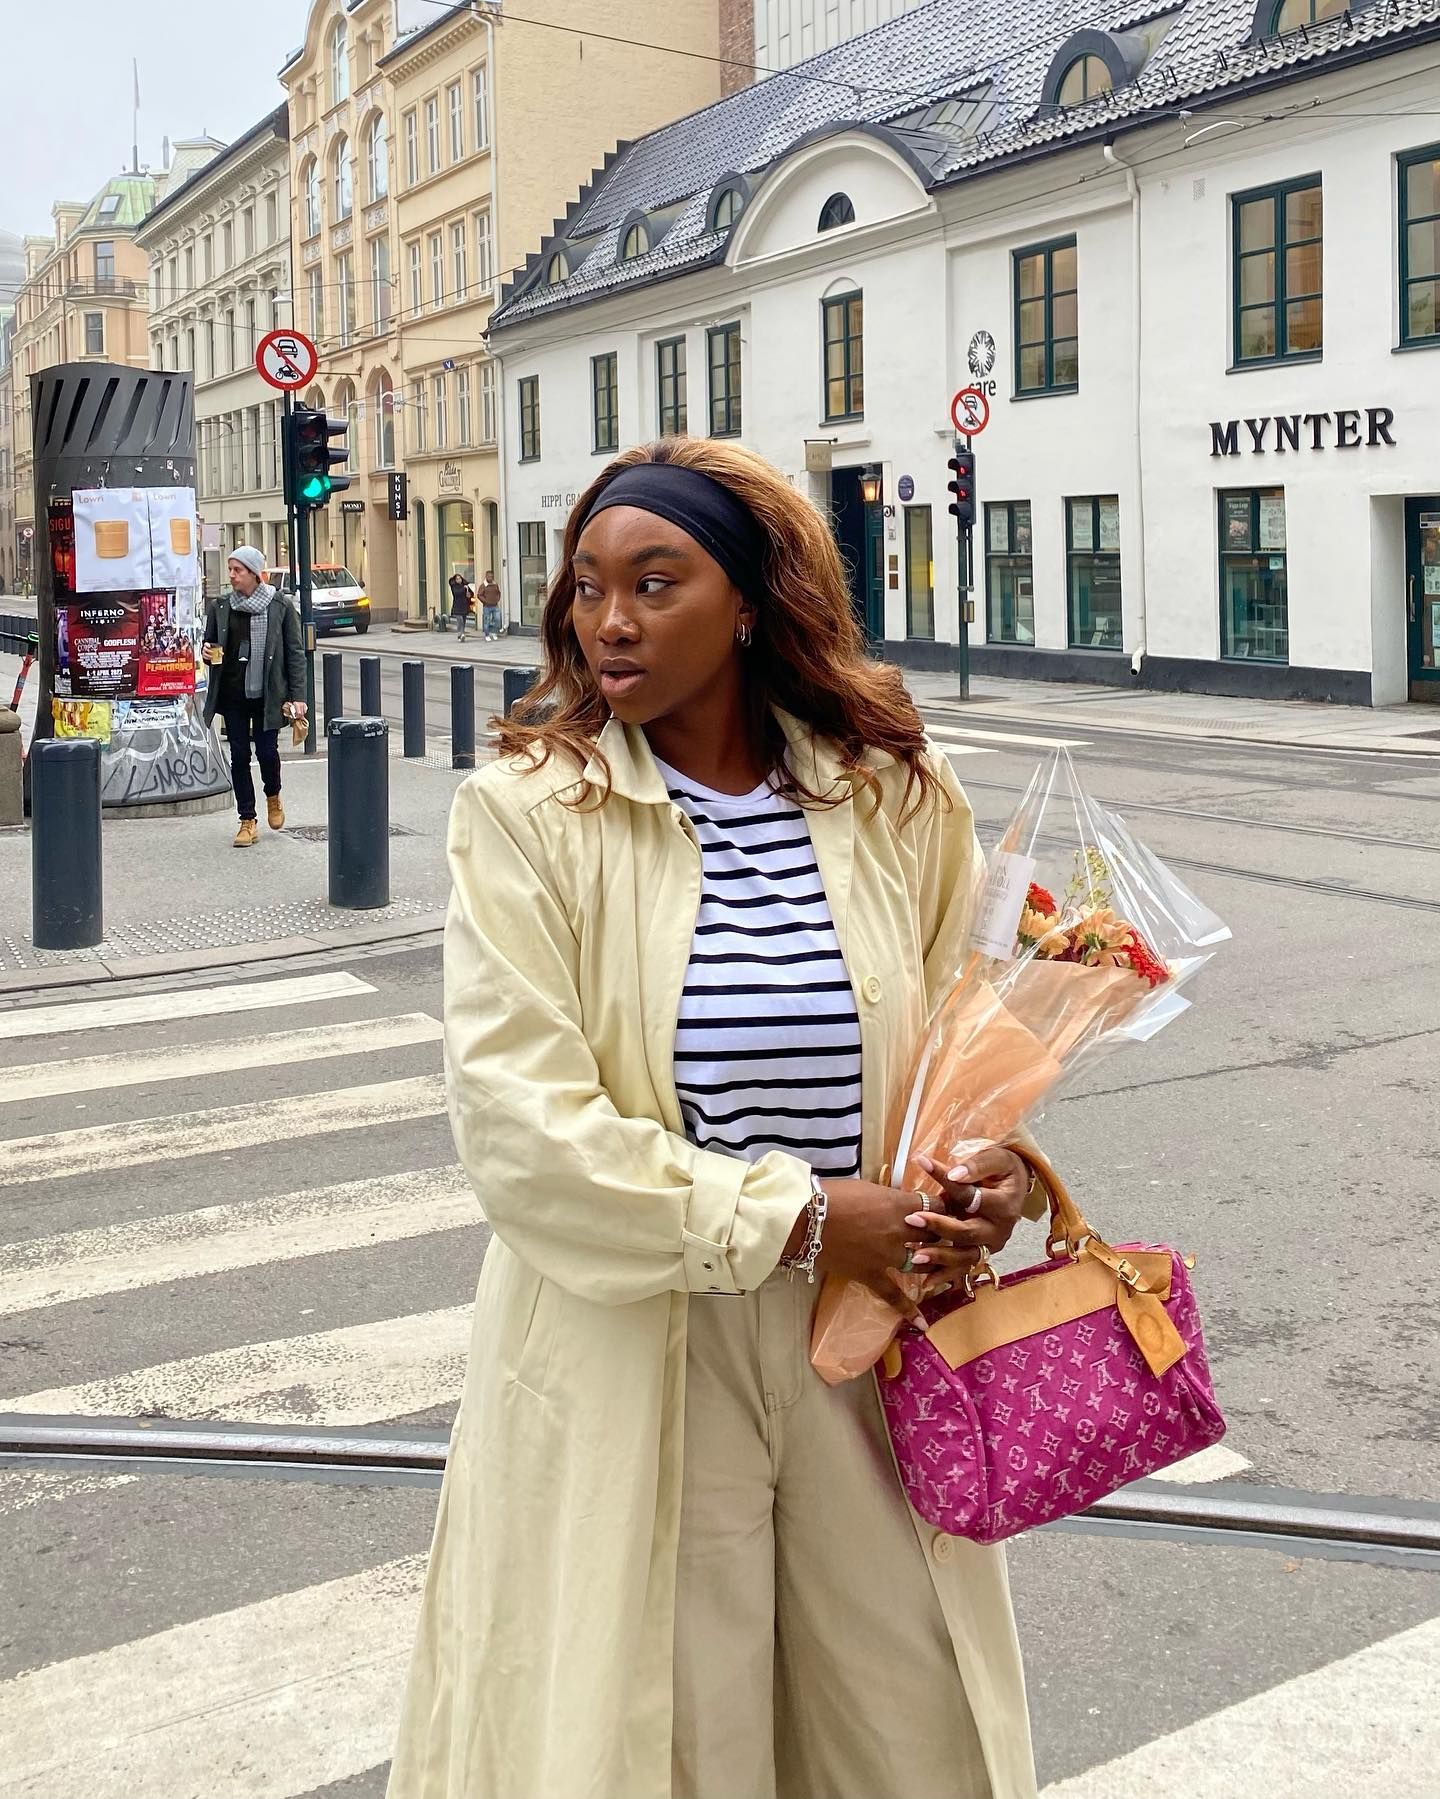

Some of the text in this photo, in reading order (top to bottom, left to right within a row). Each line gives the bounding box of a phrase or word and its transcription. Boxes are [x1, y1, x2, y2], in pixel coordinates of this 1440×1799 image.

[1208, 407, 1397, 457] MYNTER
[541, 494, 562, 508] HIPPI
[80, 608, 125, 618] INFERNO
[103, 638, 137, 647] GODFLESH
